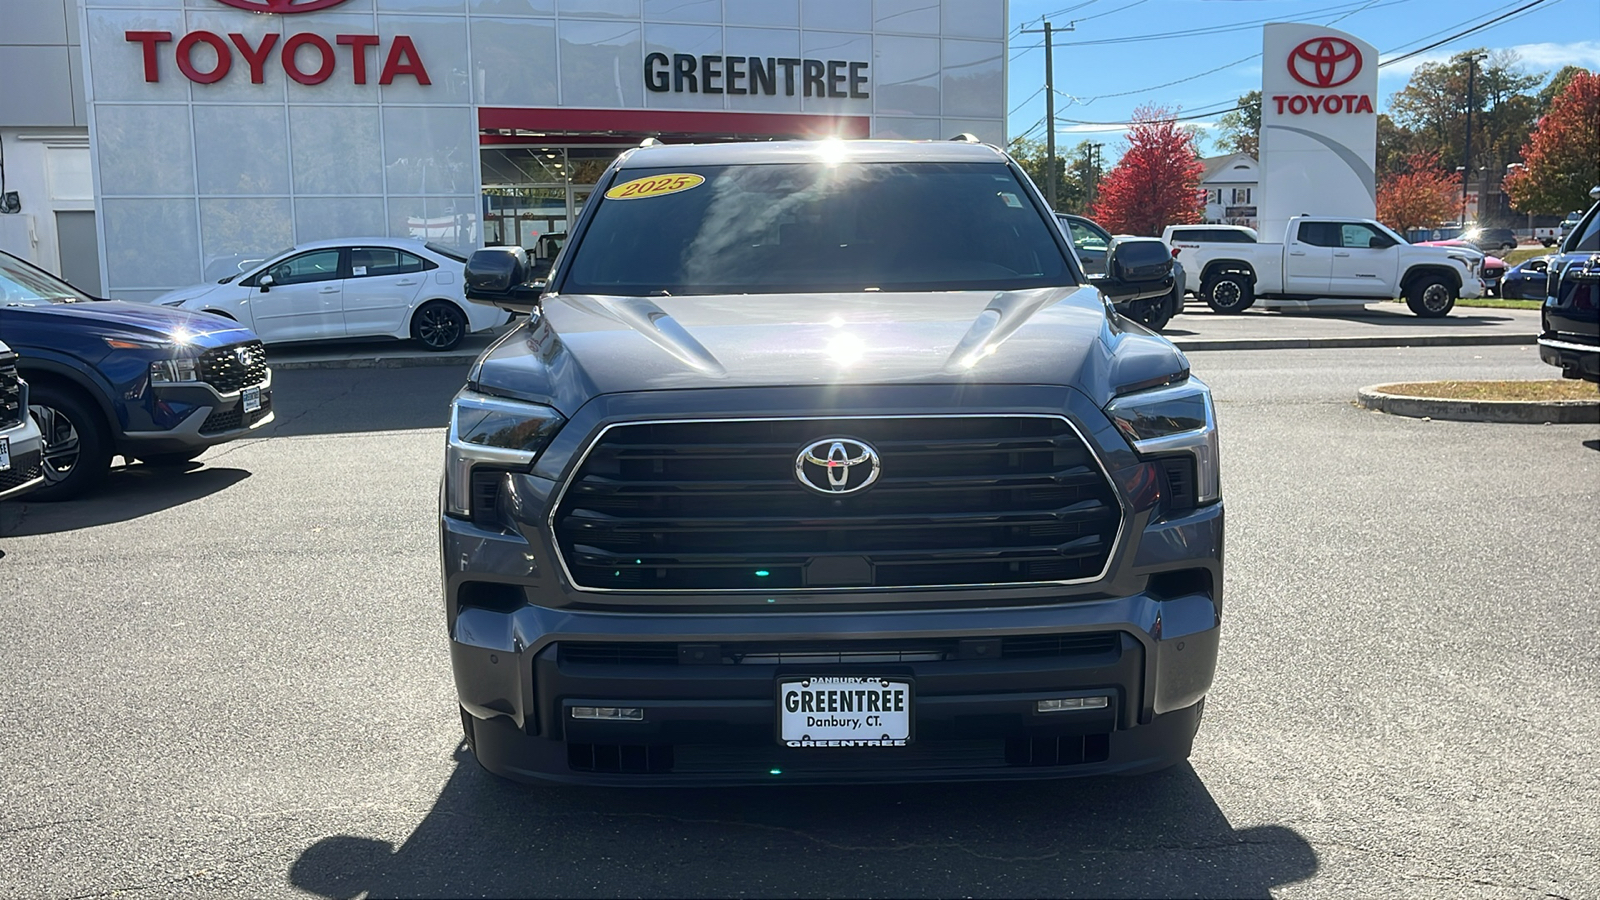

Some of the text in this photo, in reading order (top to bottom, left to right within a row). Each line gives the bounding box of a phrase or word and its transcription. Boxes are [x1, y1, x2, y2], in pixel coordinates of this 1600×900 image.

[125, 30, 432, 86] TOYOTA
[644, 51, 870, 99] GREENTREE
[1272, 94, 1373, 114] TOYOTA
[620, 176, 690, 197] 2025
[785, 690, 904, 713] GREENTREE
[807, 715, 882, 730] Danbury, CT.
